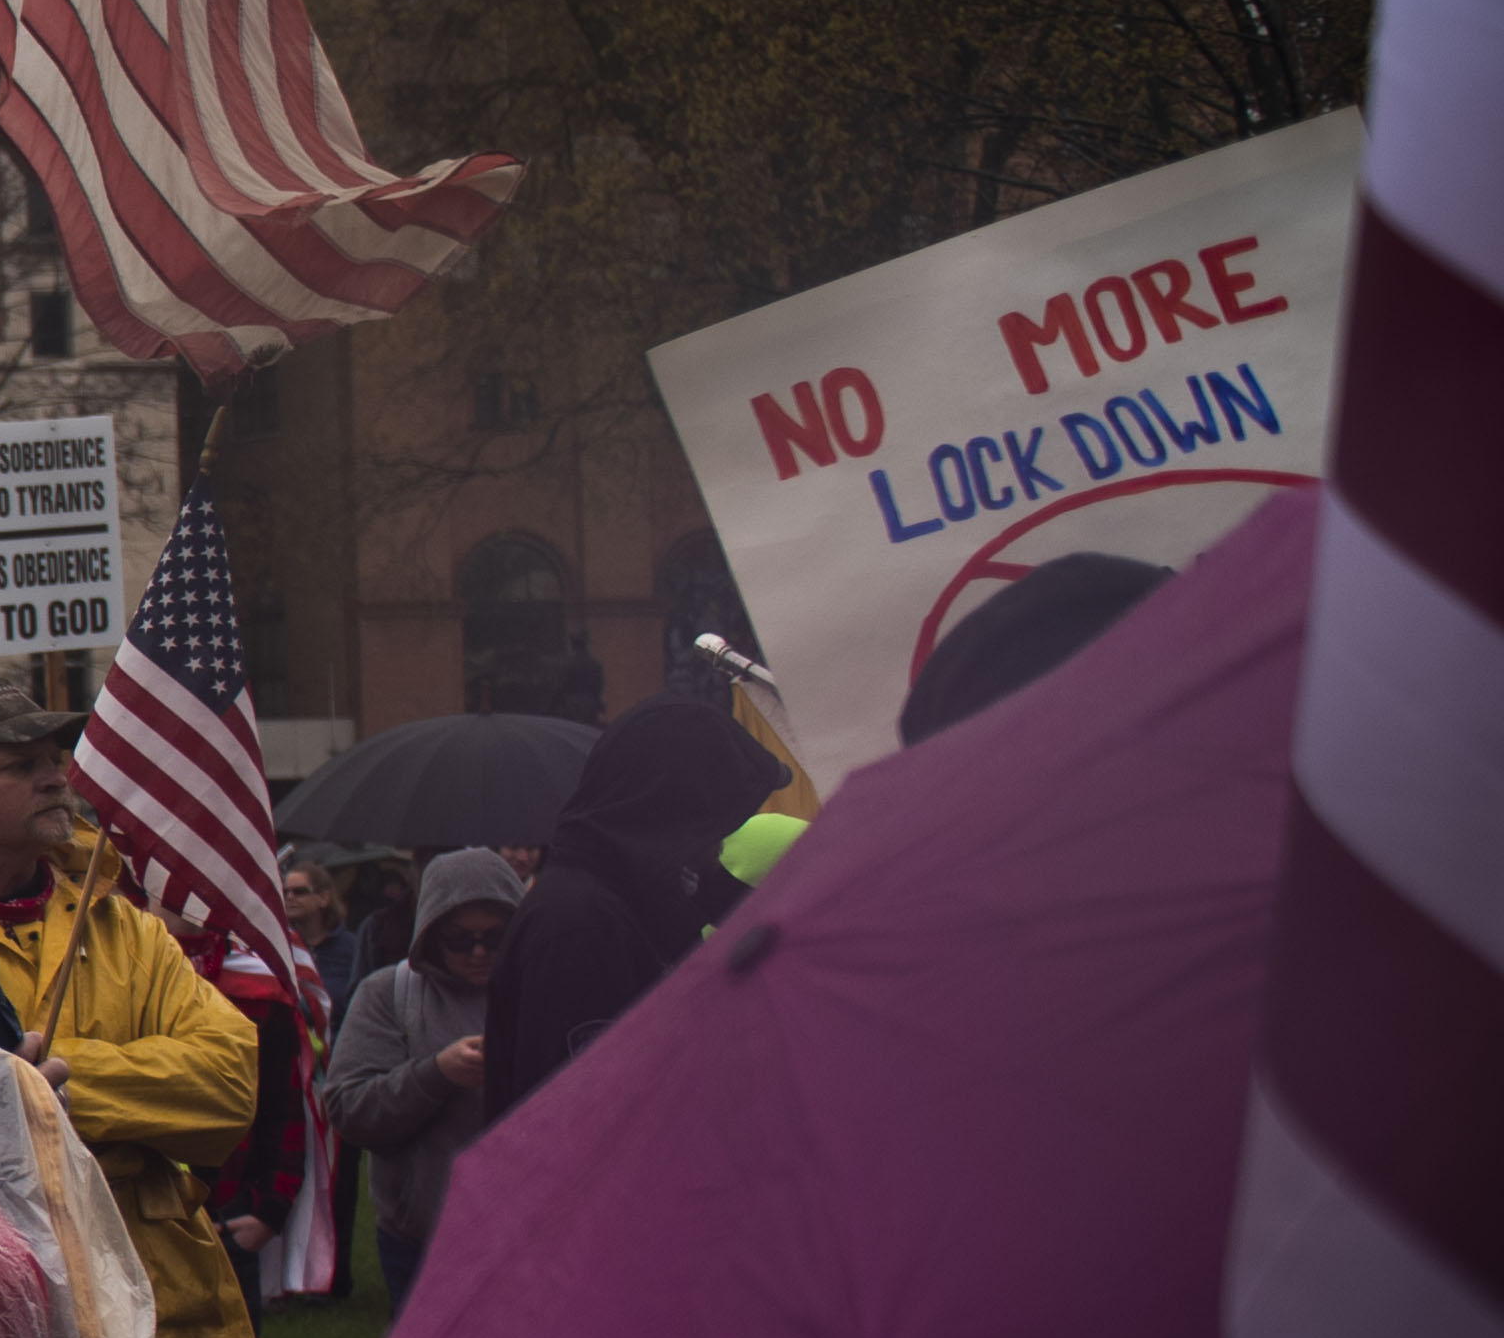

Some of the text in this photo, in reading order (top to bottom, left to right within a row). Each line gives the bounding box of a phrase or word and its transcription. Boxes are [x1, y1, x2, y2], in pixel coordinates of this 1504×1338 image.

[750, 235, 1289, 481] NO MORE
[15, 480, 105, 516] TYRANTS
[13, 546, 111, 589] OBEDIENCE
[0, 597, 110, 641] TO GOD
